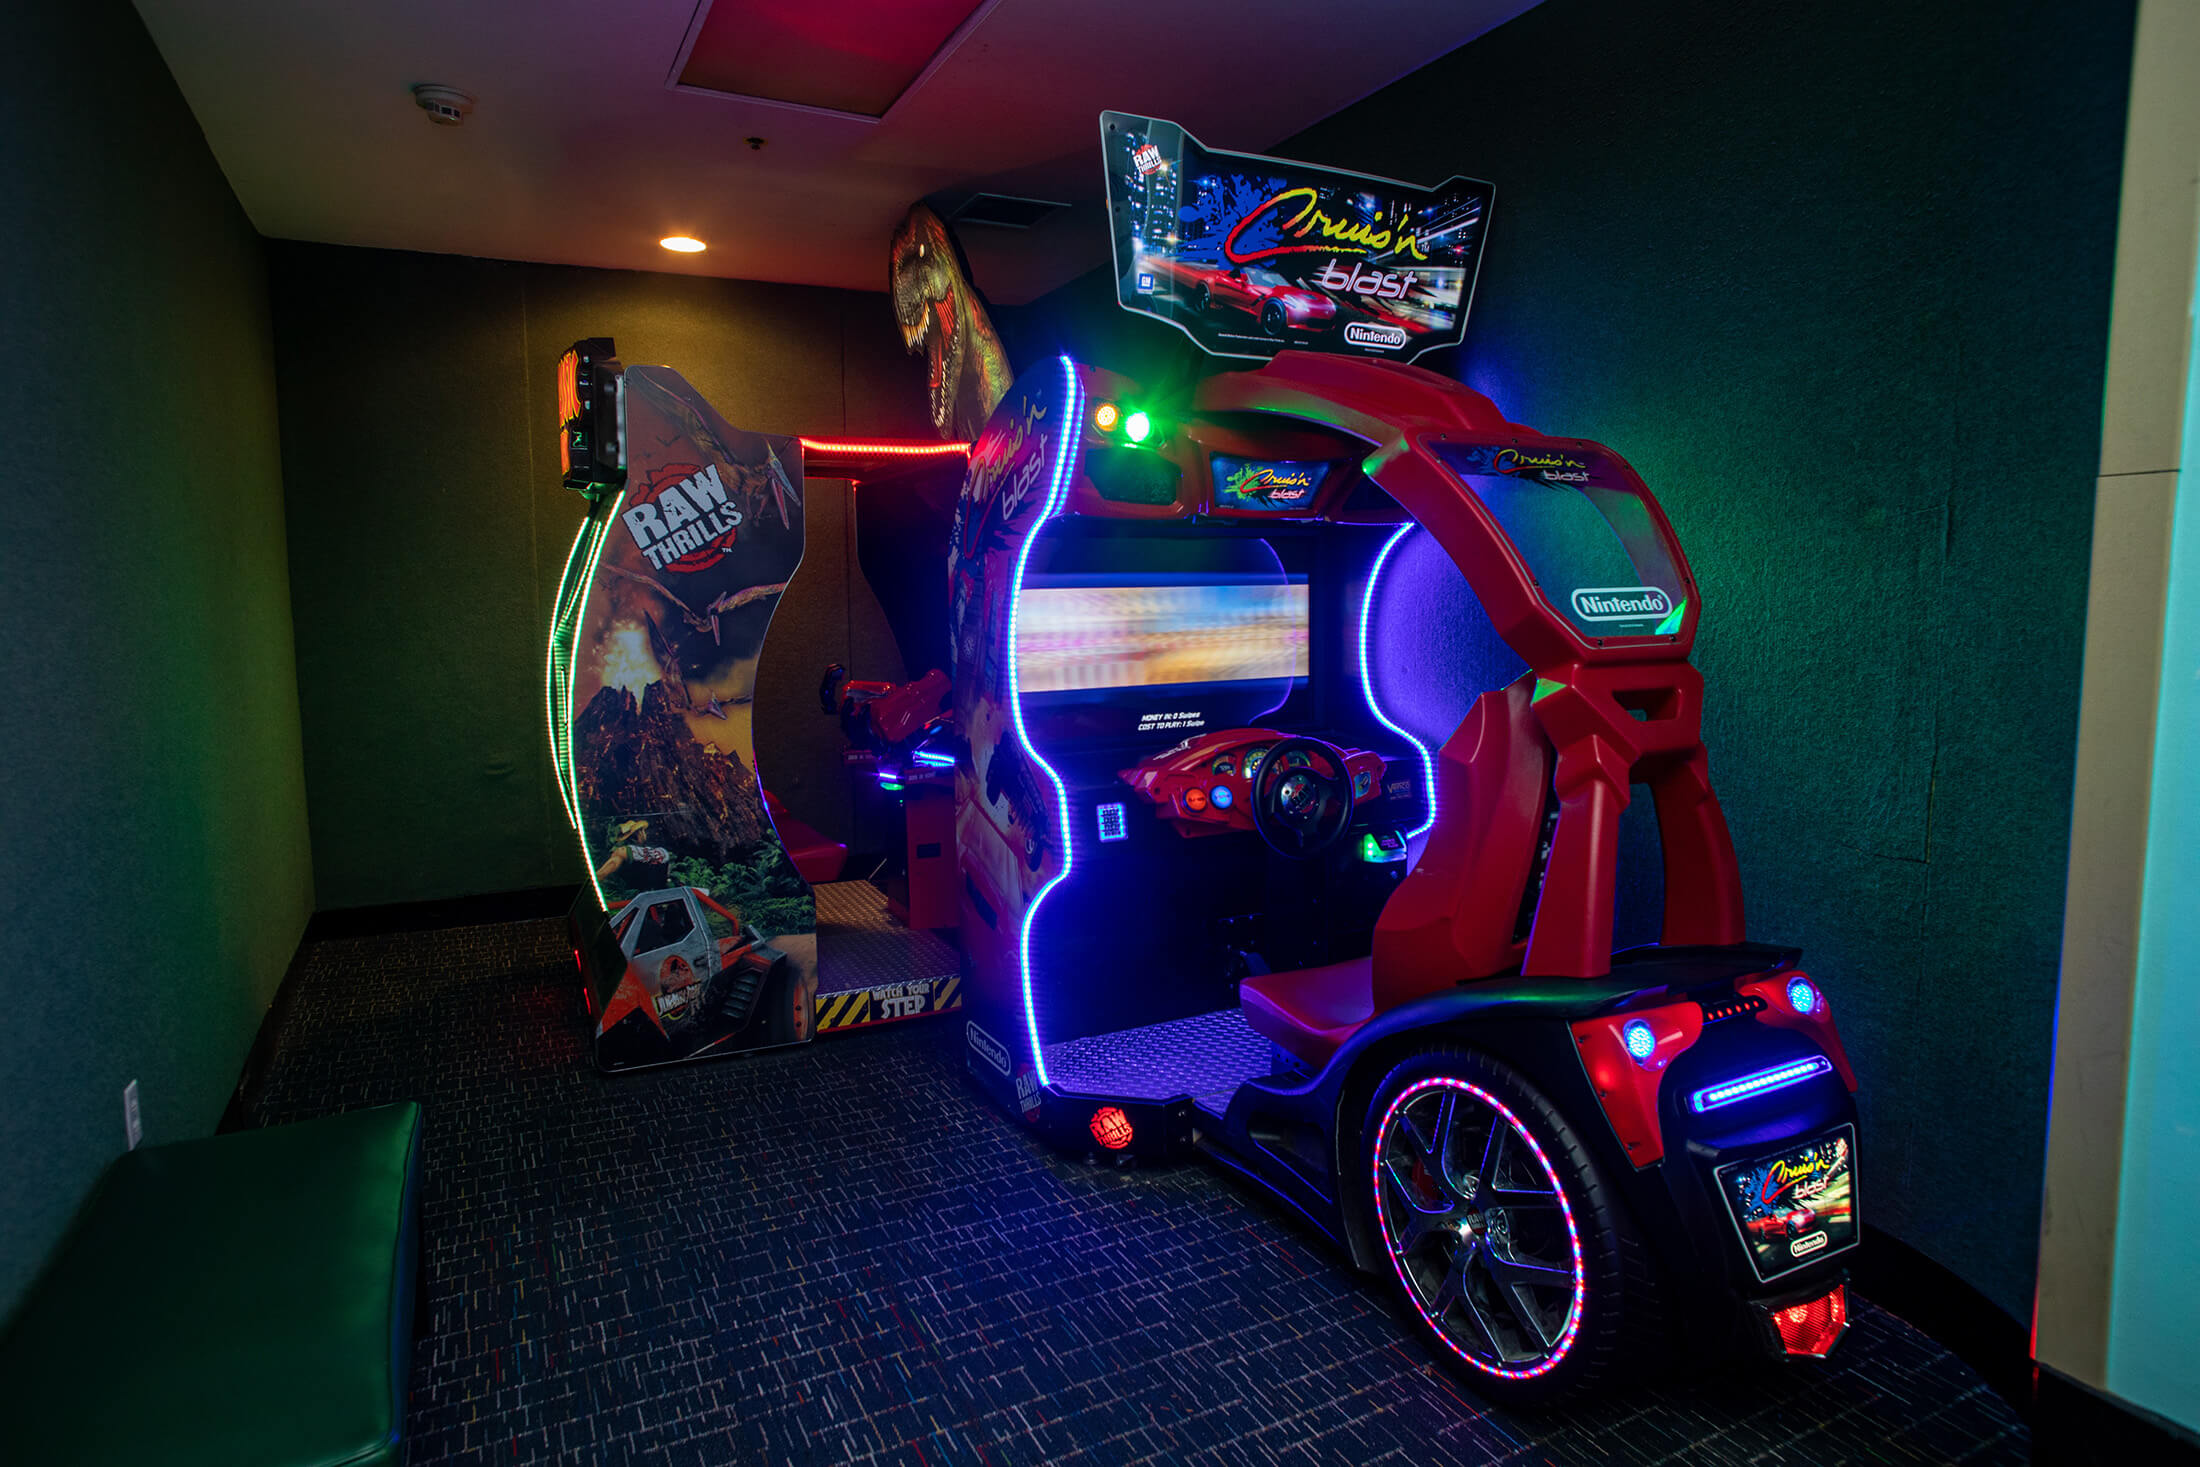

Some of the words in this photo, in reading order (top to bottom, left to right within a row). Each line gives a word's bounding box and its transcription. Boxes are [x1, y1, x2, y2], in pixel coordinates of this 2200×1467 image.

[1133, 145, 1161, 169] RAW
[1225, 187, 1427, 263] Cruis'n
[1321, 258, 1418, 299] blast
[1350, 326, 1401, 346] Nintendo
[1494, 448, 1586, 474] Cruis'n
[1002, 433, 1048, 521] blast
[1239, 468, 1310, 494] Cruis'n
[1543, 469, 1590, 482] blast
[1268, 488, 1305, 500] blast
[622, 464, 728, 550] RAW
[642, 501, 743, 571] THRILLS
[1580, 594, 1663, 614] Nintendo
[1138, 723, 1156, 731] COST
[1156, 722, 1165, 730] TO
[1165, 721, 1182, 729] PLAY:
[1141, 713, 1163, 722] MONEY
[872, 985, 904, 1001] WATCH
[906, 982, 930, 996] YOUR
[881, 995, 926, 1019] STEP
[970, 1027, 1008, 1069] Nintendo
[1015, 1069, 1039, 1100] RAW
[1020, 1091, 1042, 1114] THRILLS
[1090, 1109, 1128, 1138] RAW
[1098, 1122, 1134, 1146] THRILLS
[1762, 1152, 1830, 1205] Cruis'n
[1792, 1175, 1829, 1200] blast
[1793, 1235, 1825, 1254] Nintendo
